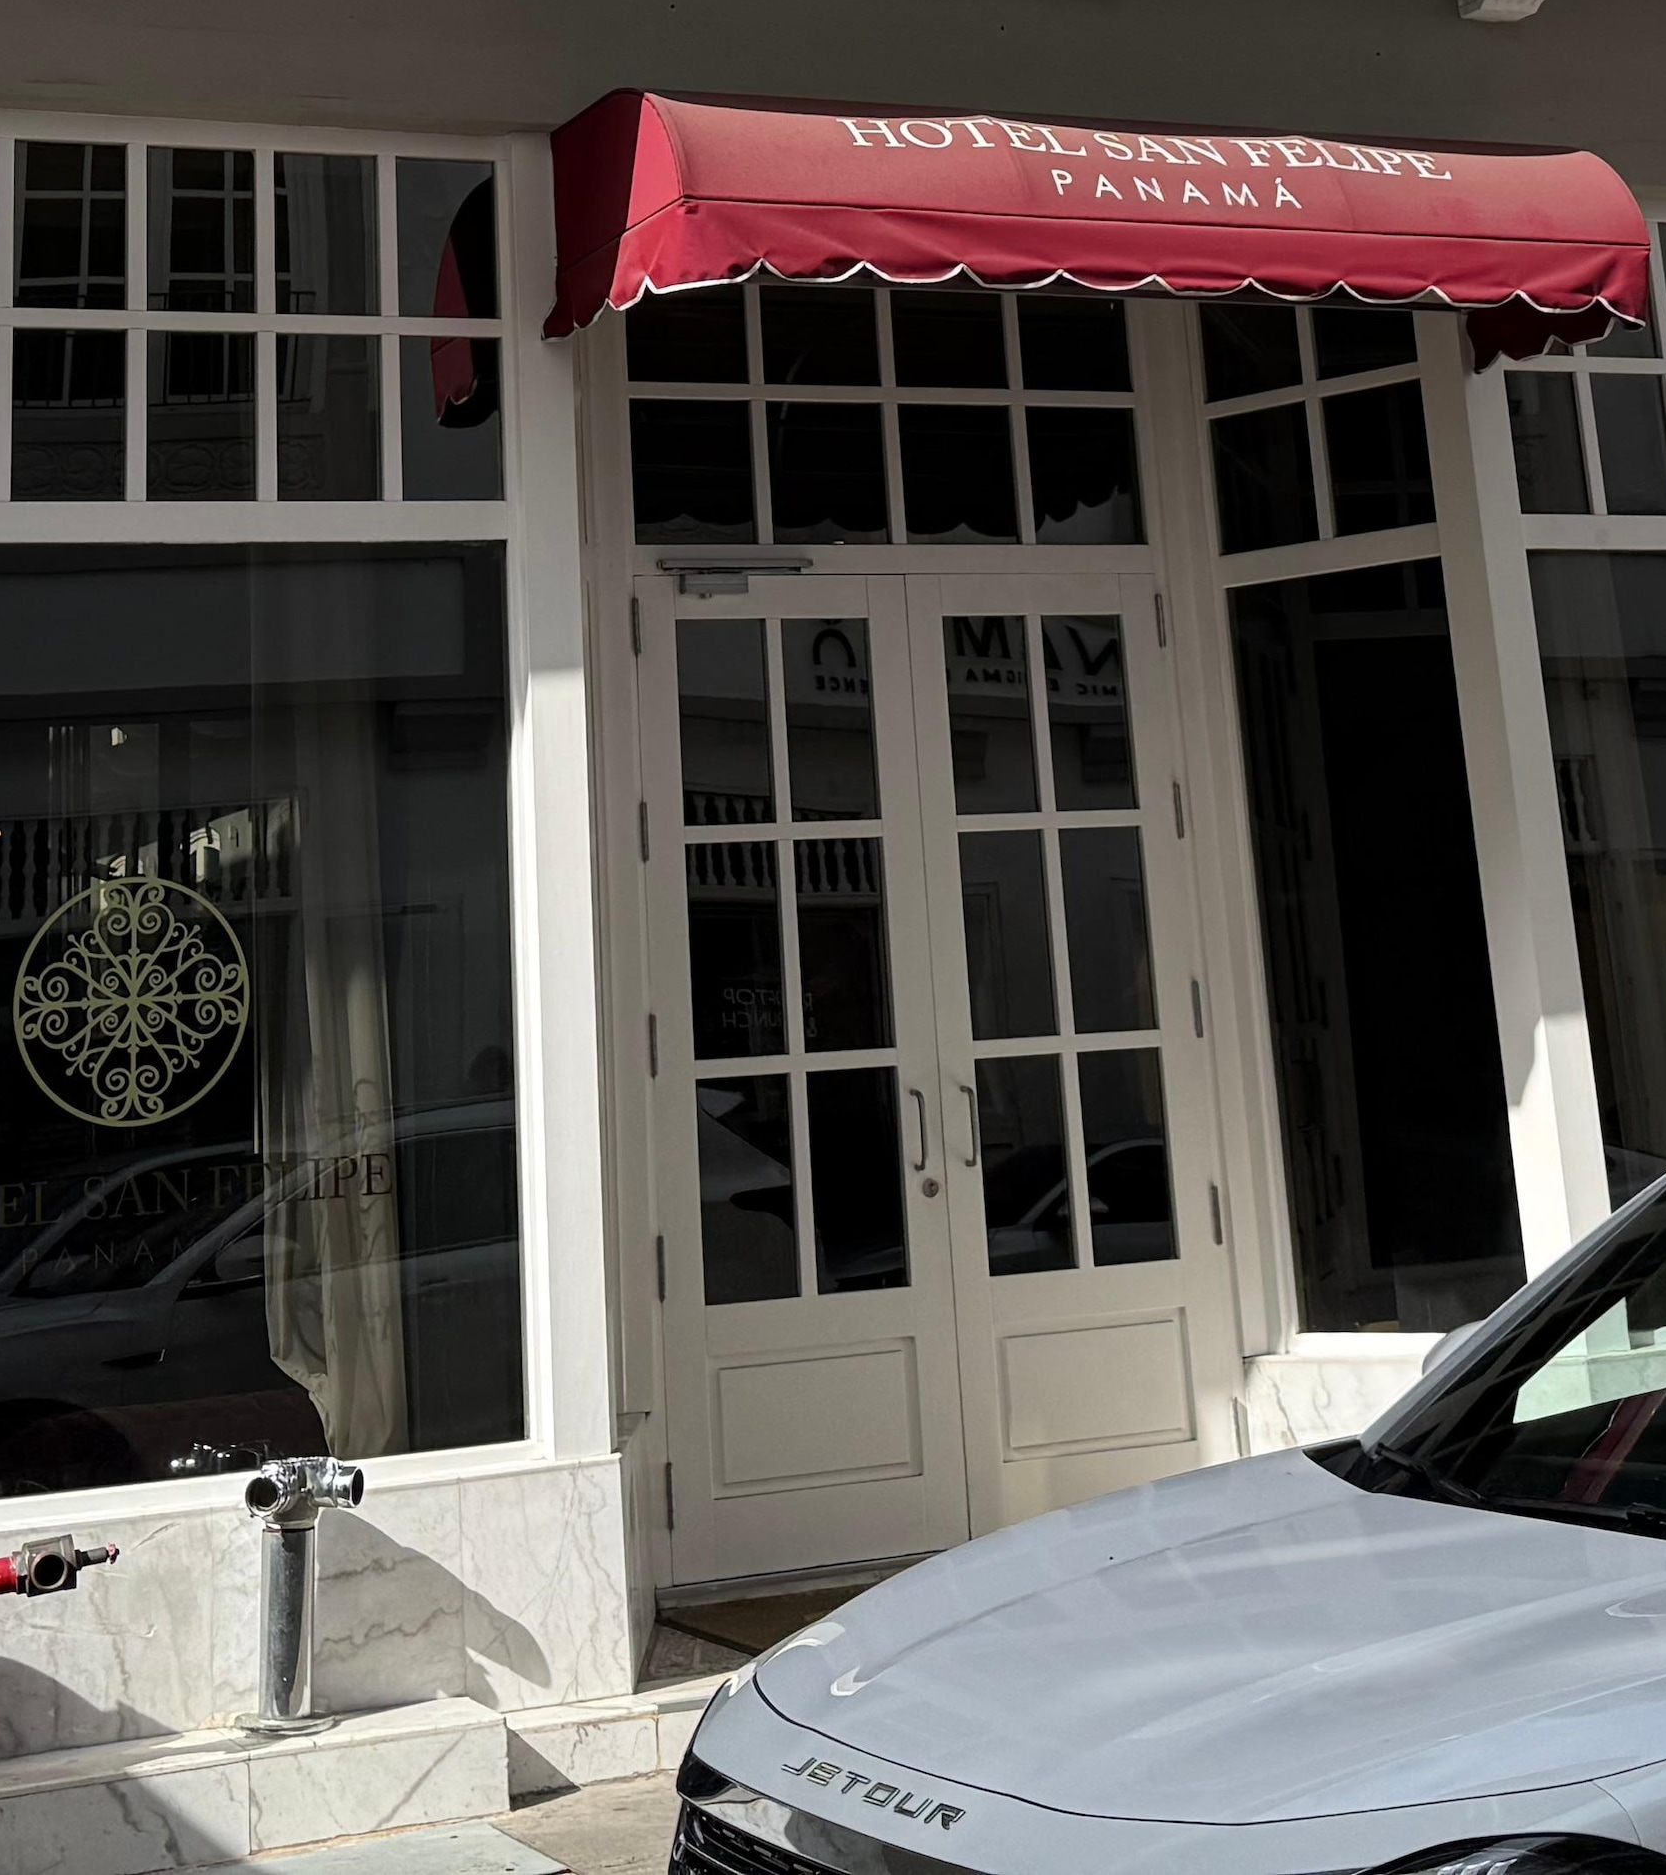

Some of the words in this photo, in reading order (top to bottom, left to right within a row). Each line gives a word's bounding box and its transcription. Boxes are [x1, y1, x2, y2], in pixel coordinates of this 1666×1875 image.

[836, 117, 1087, 157] HOTEL
[1093, 133, 1229, 166] SAN
[1229, 136, 1452, 181] FELIPE
[1050, 169, 1303, 210] PANAMÁ
[82, 1168, 191, 1221] SAN
[780, 1756, 967, 1831] JETOUR
